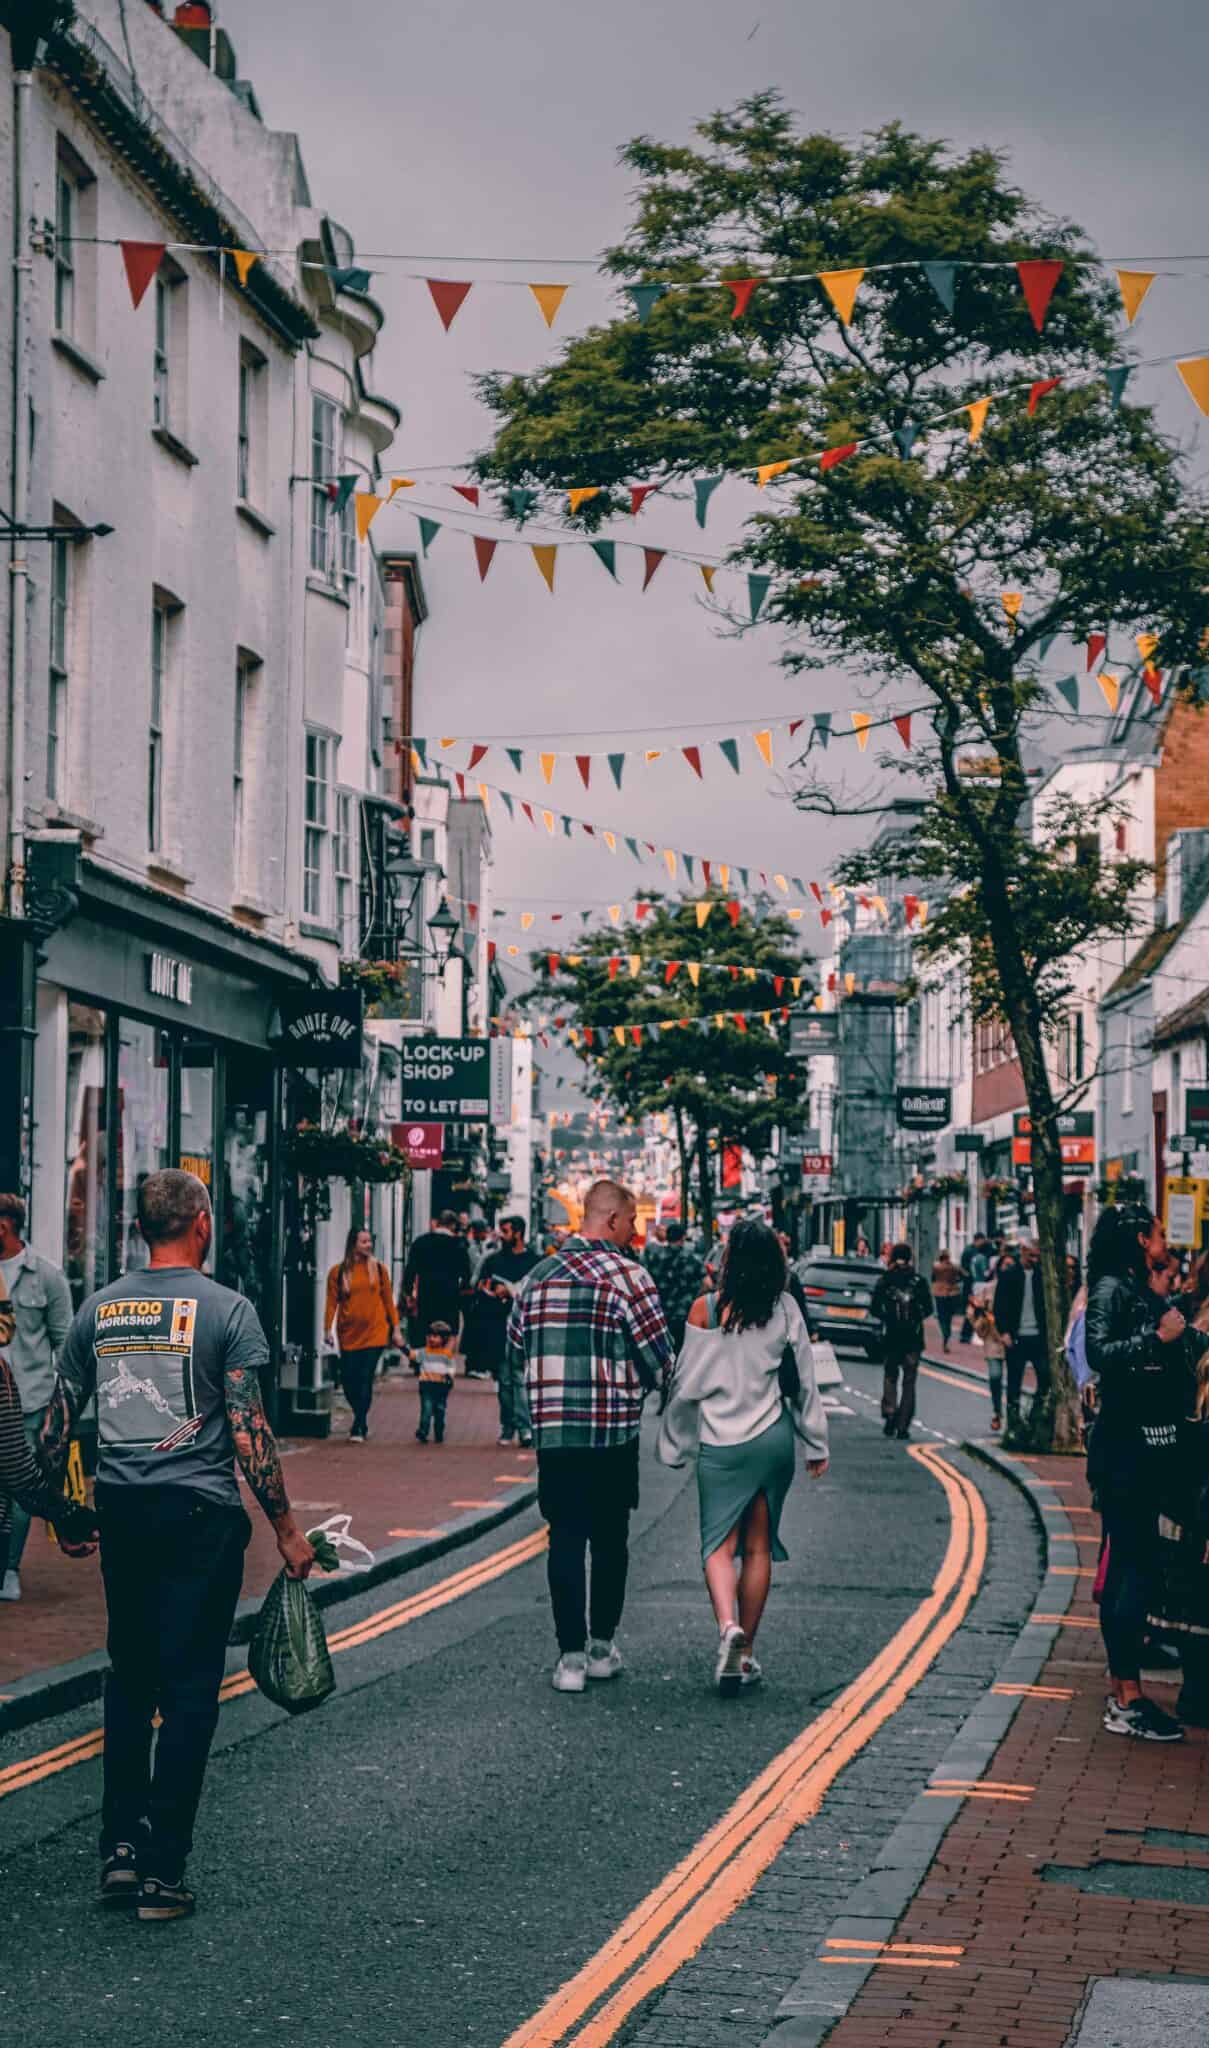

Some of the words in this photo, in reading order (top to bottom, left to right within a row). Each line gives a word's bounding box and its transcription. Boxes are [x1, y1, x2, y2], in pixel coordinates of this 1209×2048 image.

[288, 1012, 328, 1039] ROUTE
[330, 1015, 356, 1040] ONE
[403, 1045, 485, 1062] LOCK-UP
[403, 1063, 454, 1080] SHOP
[404, 1099, 426, 1113] TO
[429, 1099, 458, 1113] LET
[1061, 1144, 1081, 1158] ET
[99, 1301, 162, 1319] TATTOO
[97, 1314, 162, 1330] WORKSHOP
